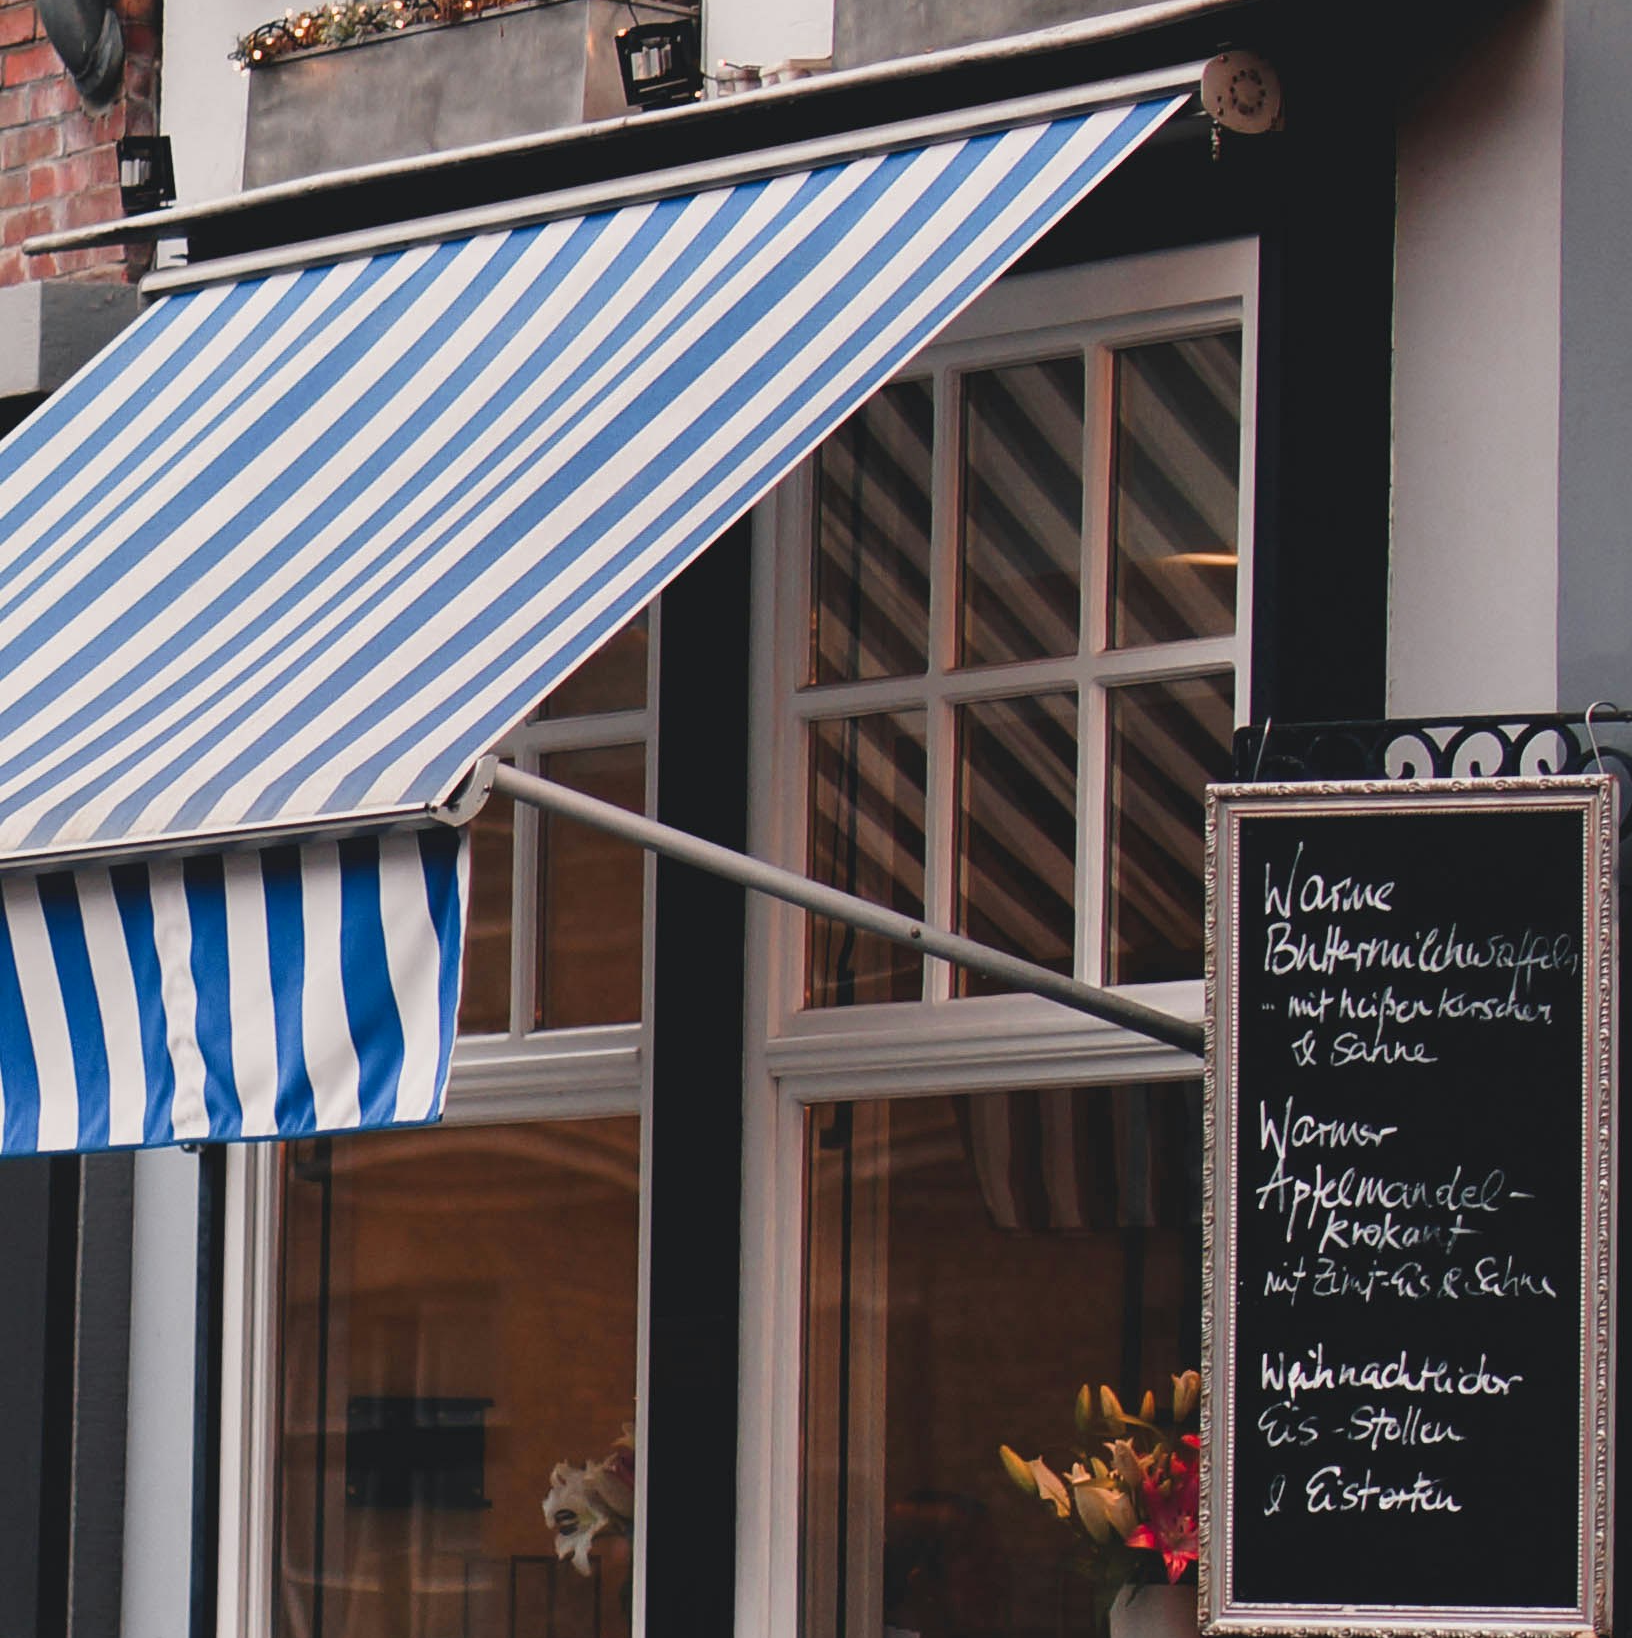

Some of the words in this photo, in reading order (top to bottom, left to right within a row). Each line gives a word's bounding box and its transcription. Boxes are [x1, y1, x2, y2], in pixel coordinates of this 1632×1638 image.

[1264, 841, 1395, 919] Warme
[1288, 987, 1334, 1024] mit
[1259, 1095, 1399, 1160] Warmer
